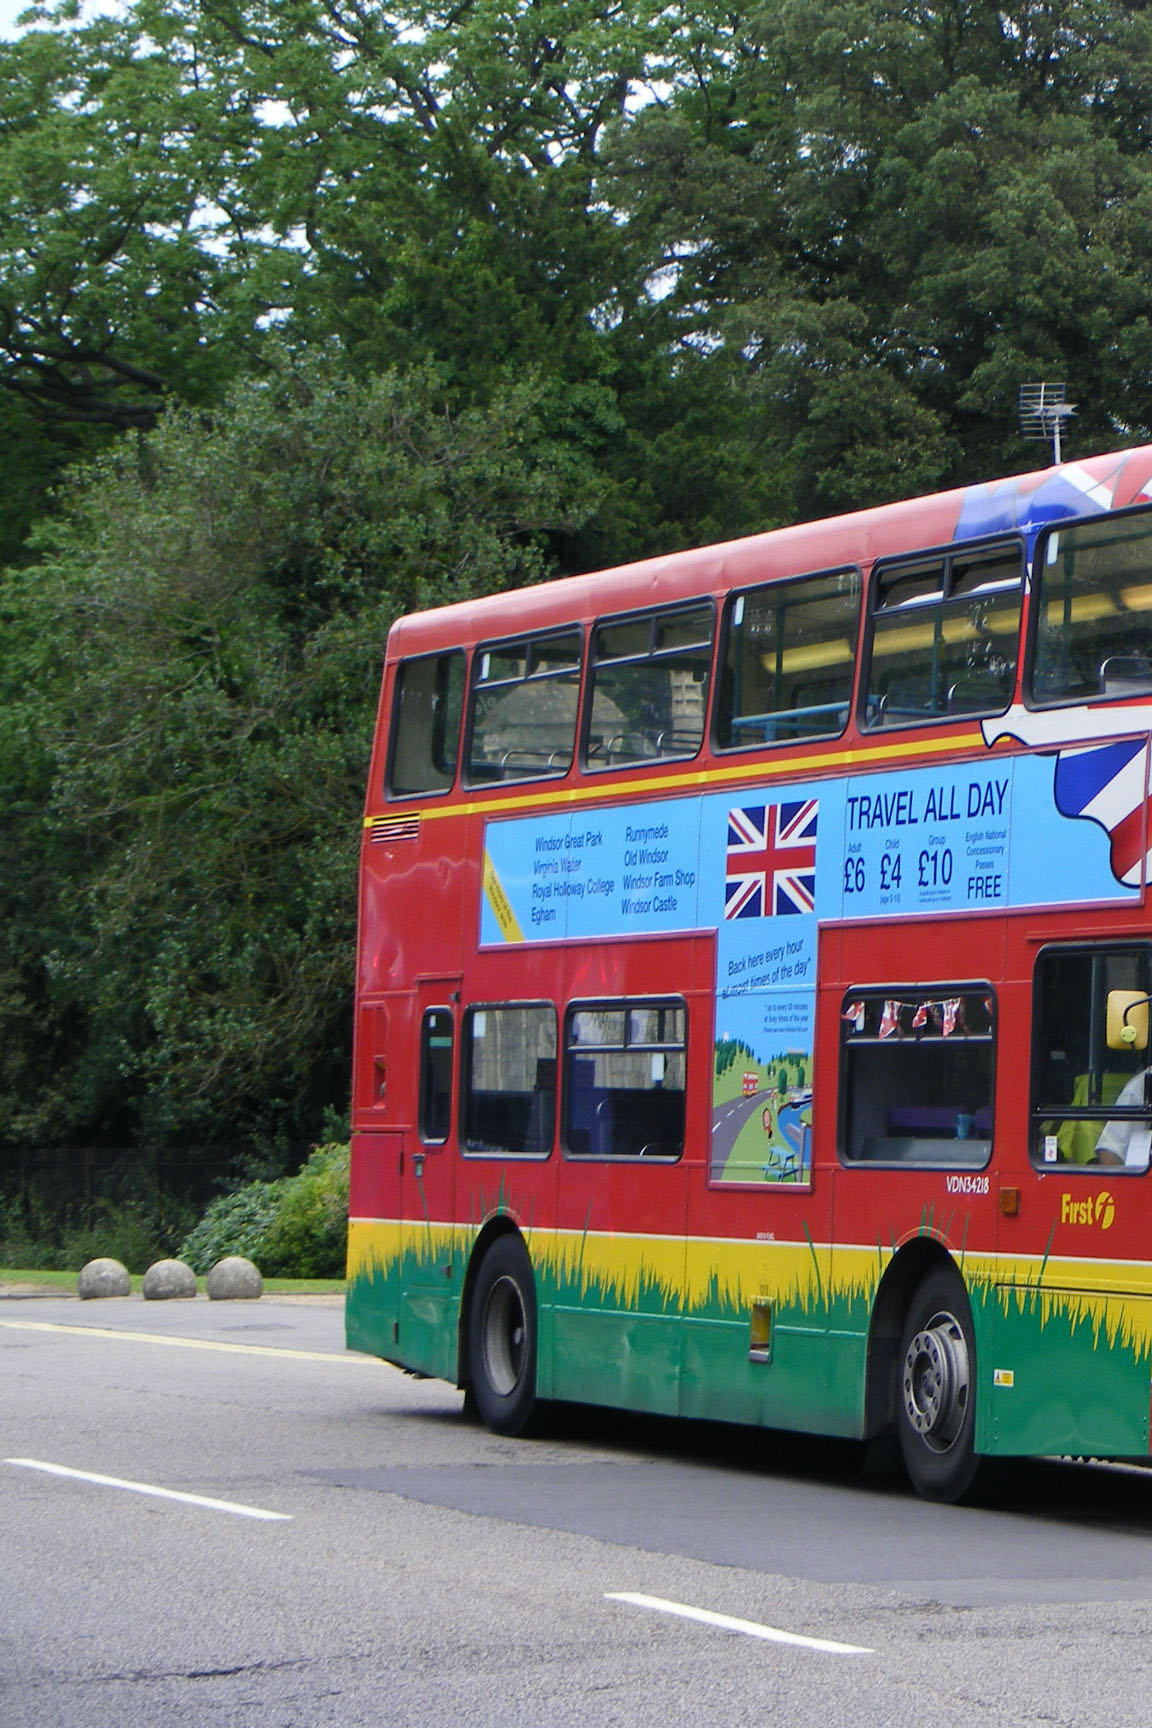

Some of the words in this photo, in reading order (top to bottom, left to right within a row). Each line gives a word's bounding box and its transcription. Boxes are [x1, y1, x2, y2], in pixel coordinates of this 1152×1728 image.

[847, 790, 918, 831] TRAVEL
[923, 785, 961, 824] ALL
[967, 778, 1009, 818] DAY
[536, 835, 563, 852] Windsor
[564, 832, 584, 849] Great
[586, 830, 603, 846] Park
[626, 823, 669, 844] Runnymede
[885, 838, 900, 850] Child
[928, 834, 946, 847] Group
[624, 850, 637, 867] Old
[639, 847, 669, 865] Windsor
[918, 848, 953, 887] £10
[533, 859, 558, 879] Virginia
[560, 858, 581, 873] Water
[844, 857, 865, 893] £6
[880, 853, 902, 890] £4
[532, 883, 552, 902] Royal
[553, 881, 585, 899] Holloway
[587, 878, 615, 897] College
[623, 873, 653, 891] Windsor
[654, 871, 674, 888] Farm
[675, 869, 696, 889] Shop
[967, 874, 1002, 899] FREE
[621, 897, 652, 915] Windsor
[653, 895, 678, 912] Castle
[531, 907, 556, 926] Egham
[728, 956, 747, 976] Back
[748, 954, 764, 969] here
[765, 946, 785, 962] every
[786, 939, 804, 956] hour
[750, 973, 770, 990] times
[771, 966, 780, 983] of
[781, 964, 793, 980] the
[946, 1175, 990, 1195] VDN34218
[1061, 1193, 1093, 1226] First
